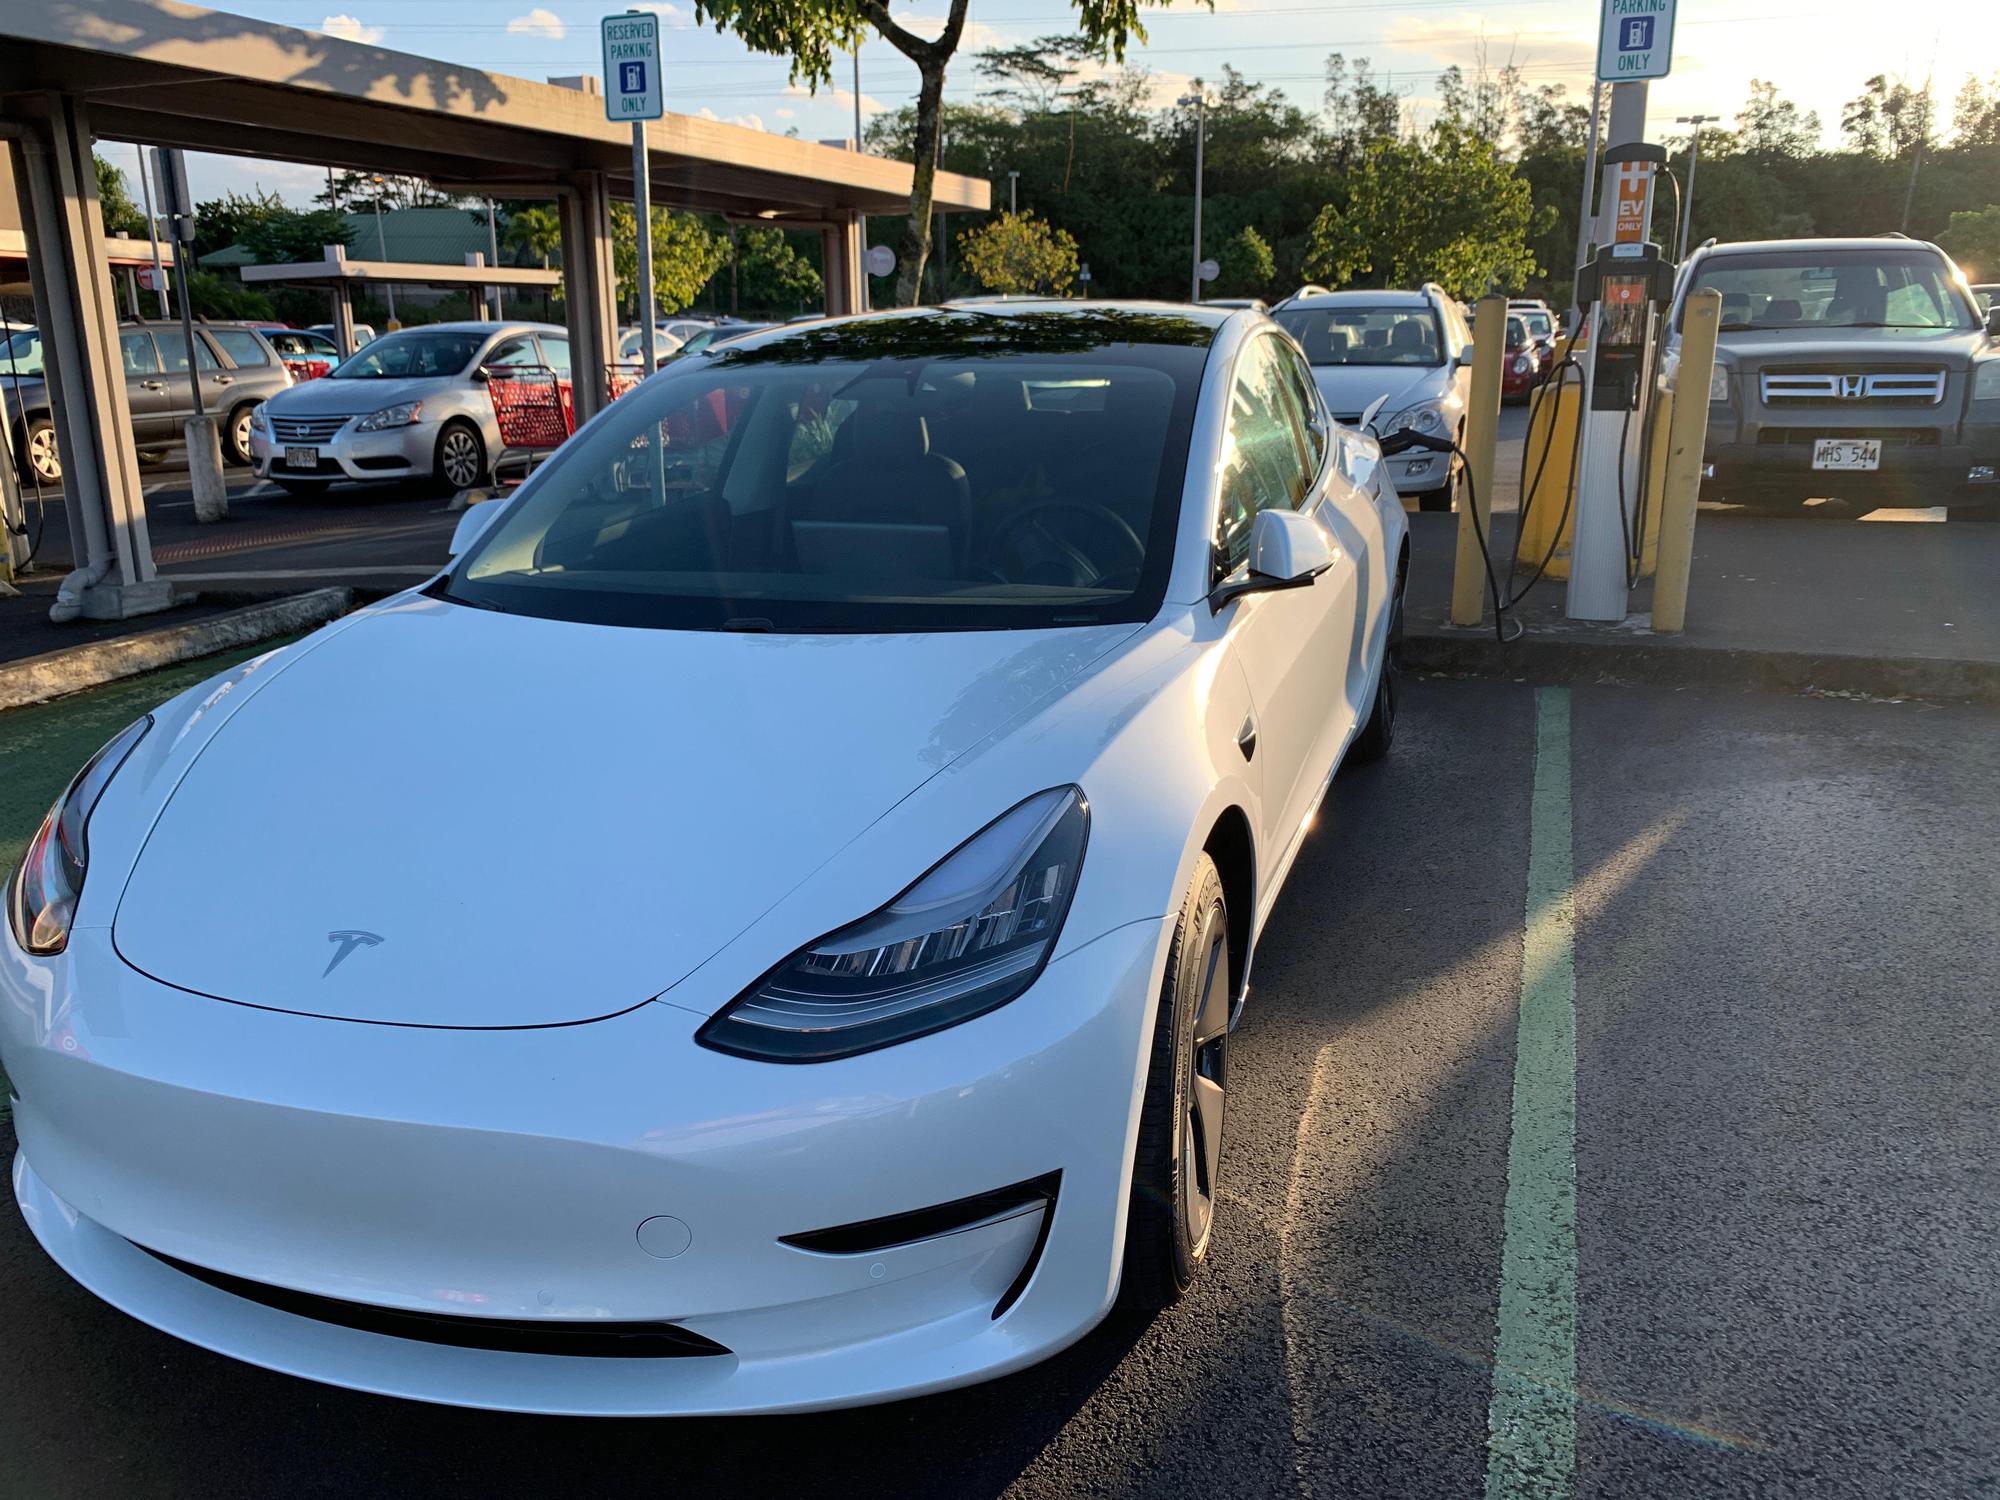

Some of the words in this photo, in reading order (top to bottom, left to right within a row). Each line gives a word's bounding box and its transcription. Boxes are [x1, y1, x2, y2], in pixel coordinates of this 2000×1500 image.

[1613, 0, 1666, 15] PARKING
[607, 22, 654, 41] RESERVED
[610, 42, 652, 59] PARKING
[1617, 53, 1650, 71] ONLY
[621, 97, 647, 113] ONLY
[1619, 200, 1645, 216] EV
[1617, 221, 1643, 232] ONLY
[1851, 446, 1878, 463] 544
